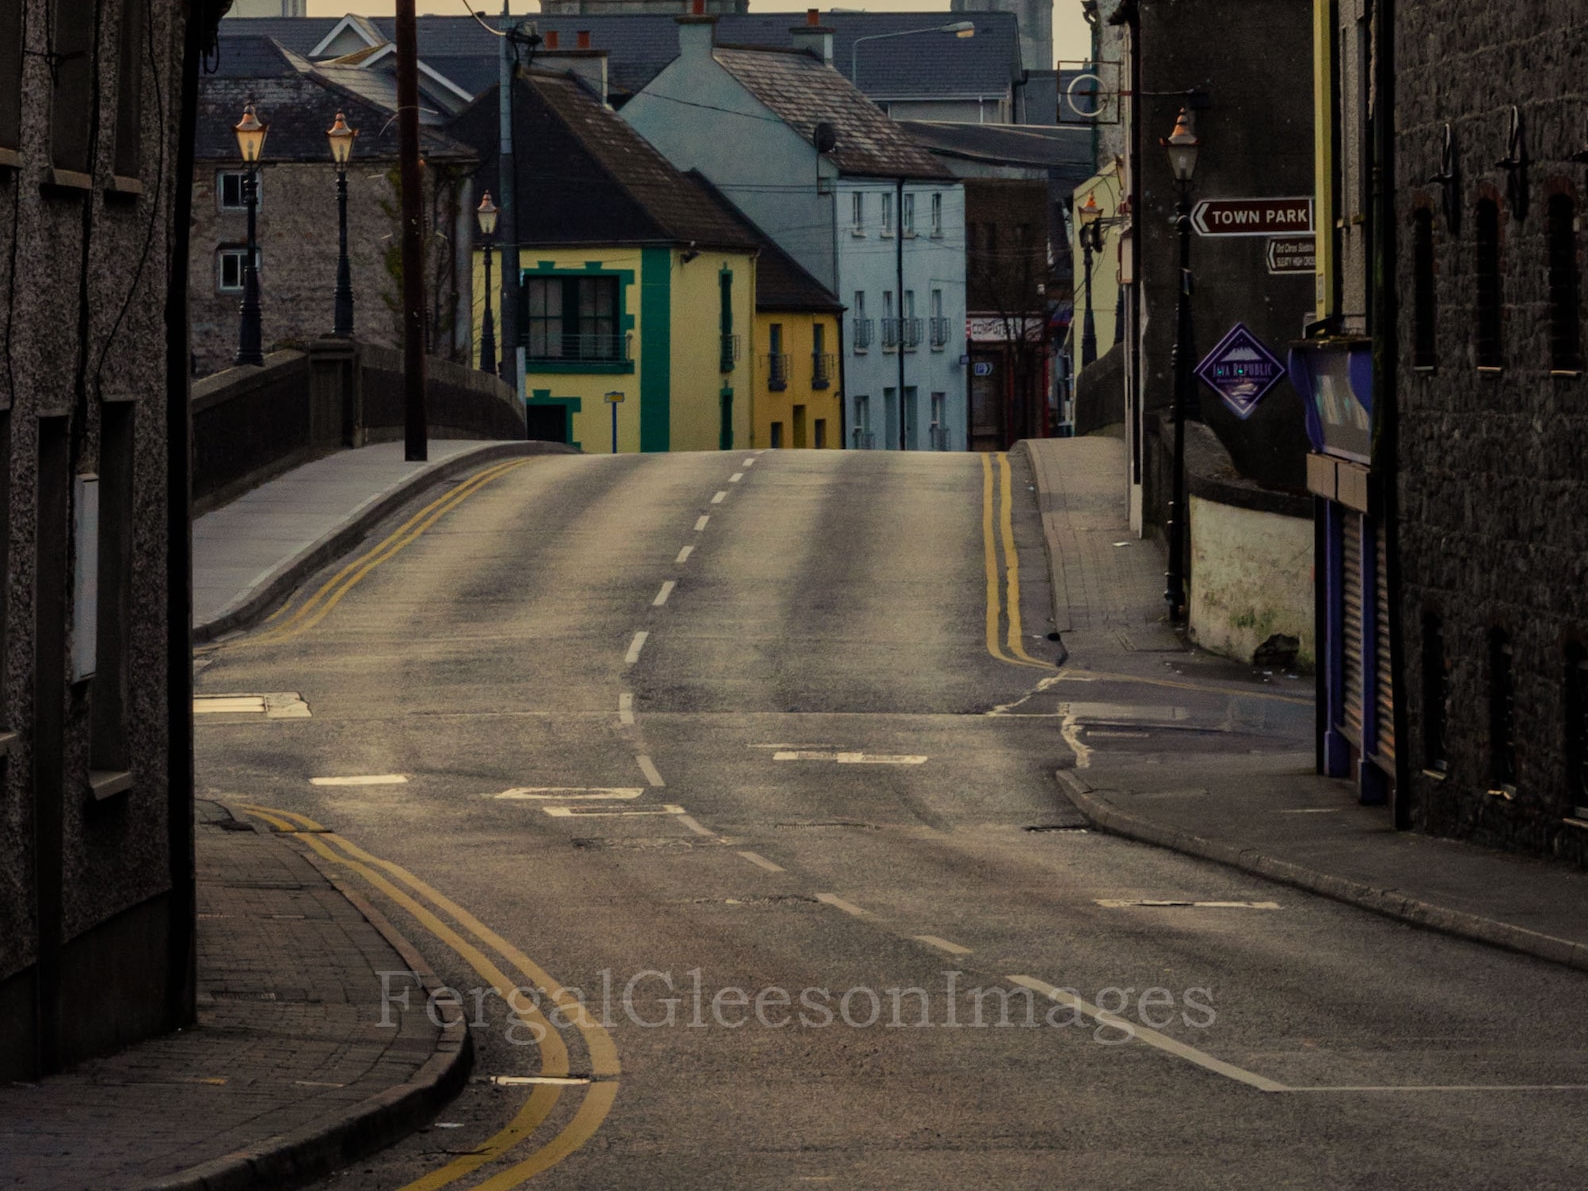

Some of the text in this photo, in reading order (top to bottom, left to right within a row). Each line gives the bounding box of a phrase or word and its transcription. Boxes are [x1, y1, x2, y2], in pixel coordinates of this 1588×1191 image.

[1212, 209, 1308, 224] TOWN PARK
[1212, 362, 1272, 377] JAVA REPUBLIC
